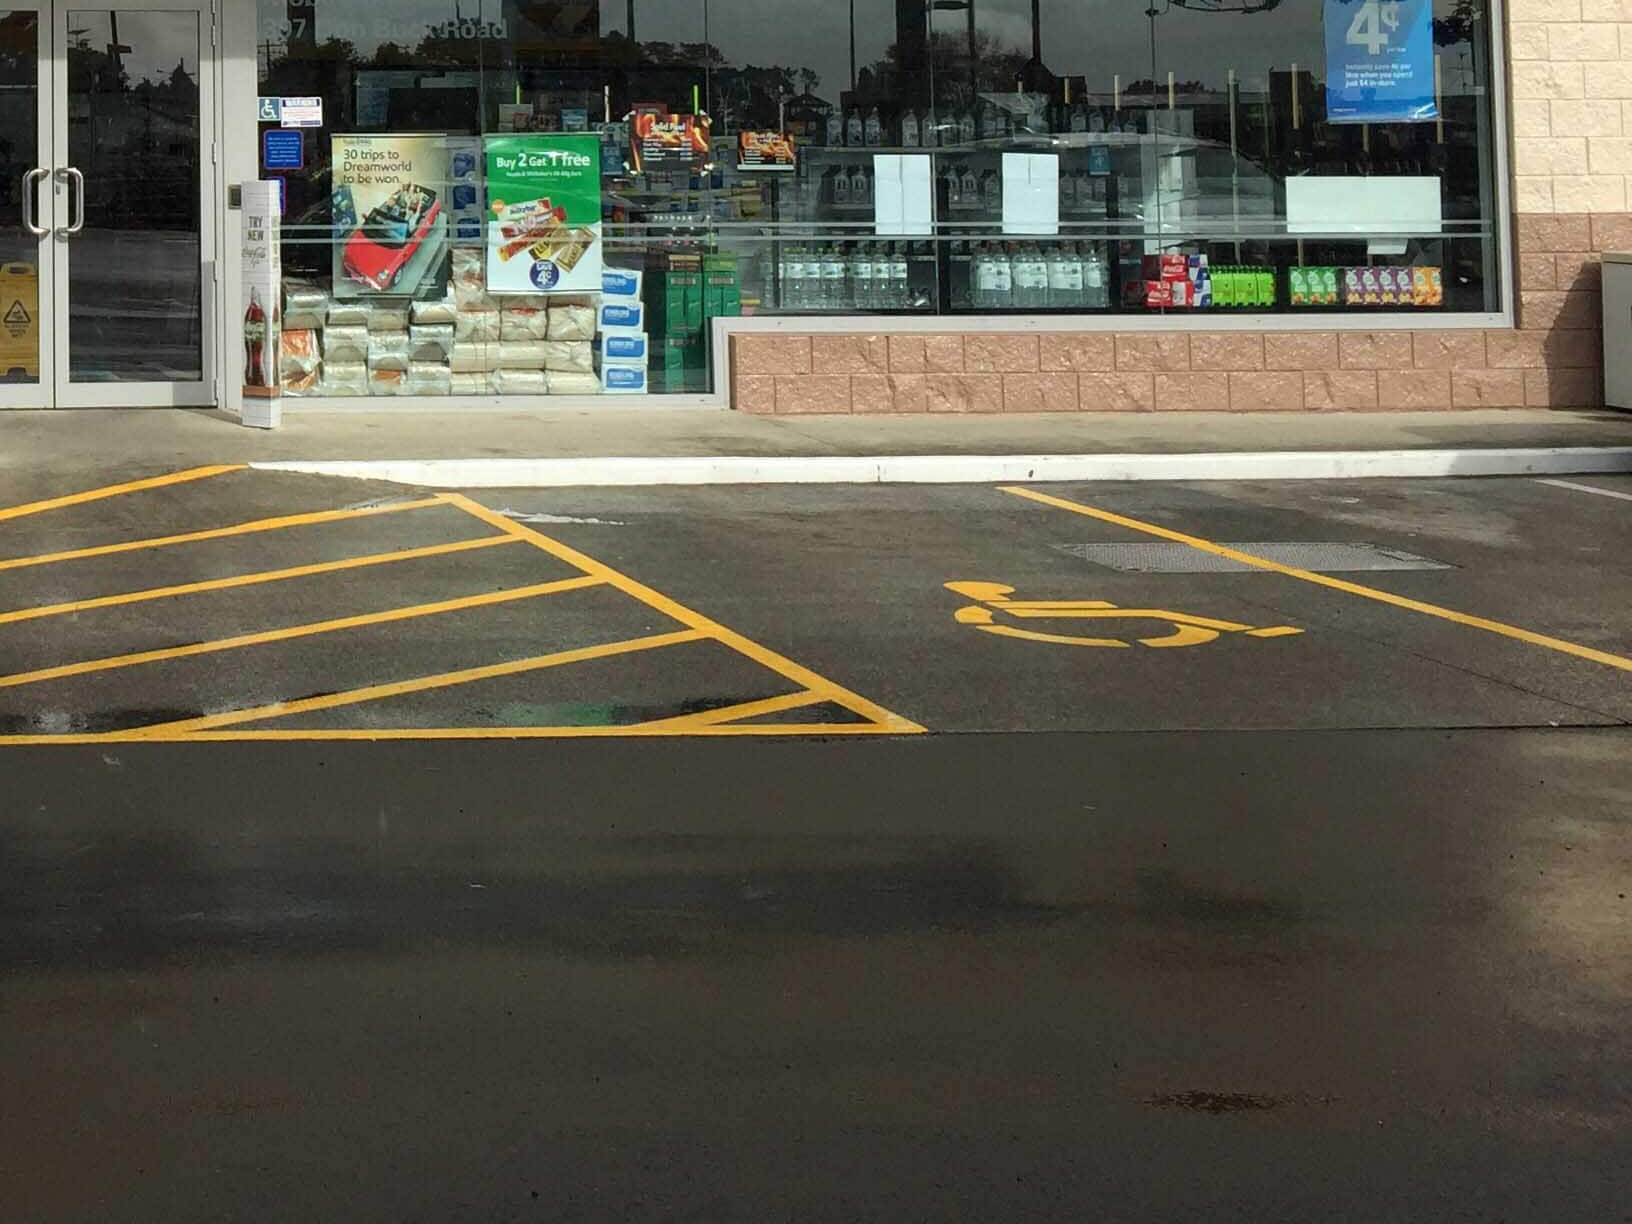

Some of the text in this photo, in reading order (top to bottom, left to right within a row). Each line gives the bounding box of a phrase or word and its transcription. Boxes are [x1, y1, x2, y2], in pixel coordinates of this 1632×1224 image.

[443, 18, 508, 39] Road
[343, 149, 400, 162] 30 trips to
[496, 157, 516, 171] Buy
[518, 153, 527, 167] 2
[529, 157, 547, 167] Get
[562, 152, 591, 167] free
[343, 160, 412, 172] Dreamworld
[342, 174, 355, 184] to
[357, 173, 371, 184] be
[248, 216, 264, 228] TRY
[247, 229, 265, 241] NEW
